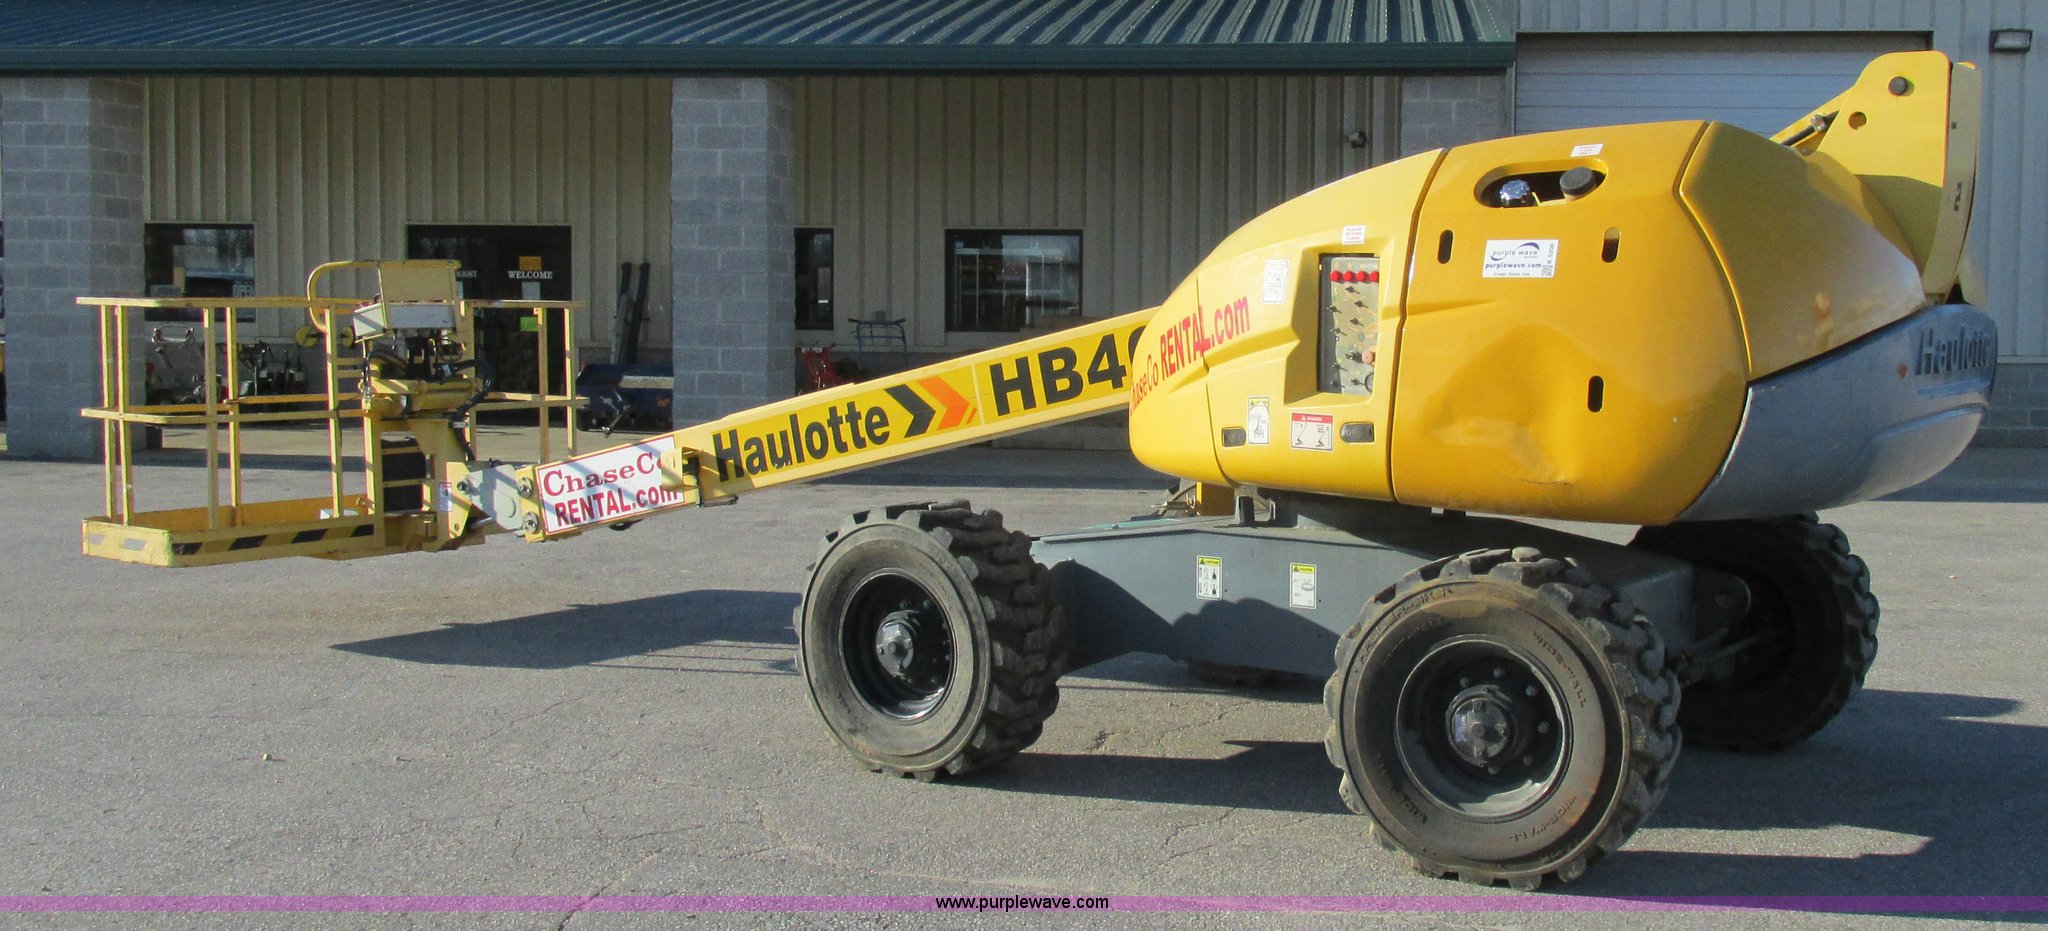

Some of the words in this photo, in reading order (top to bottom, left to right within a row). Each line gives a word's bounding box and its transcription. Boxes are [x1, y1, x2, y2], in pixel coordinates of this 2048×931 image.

[508, 271, 553, 279] WELCOME
[1130, 354, 1159, 417] haseCo
[1160, 296, 1250, 381] RENTAL.com
[713, 400, 890, 482] Haulotte
[543, 452, 662, 497] ChaseC
[554, 485, 678, 527] RENTAL.com
